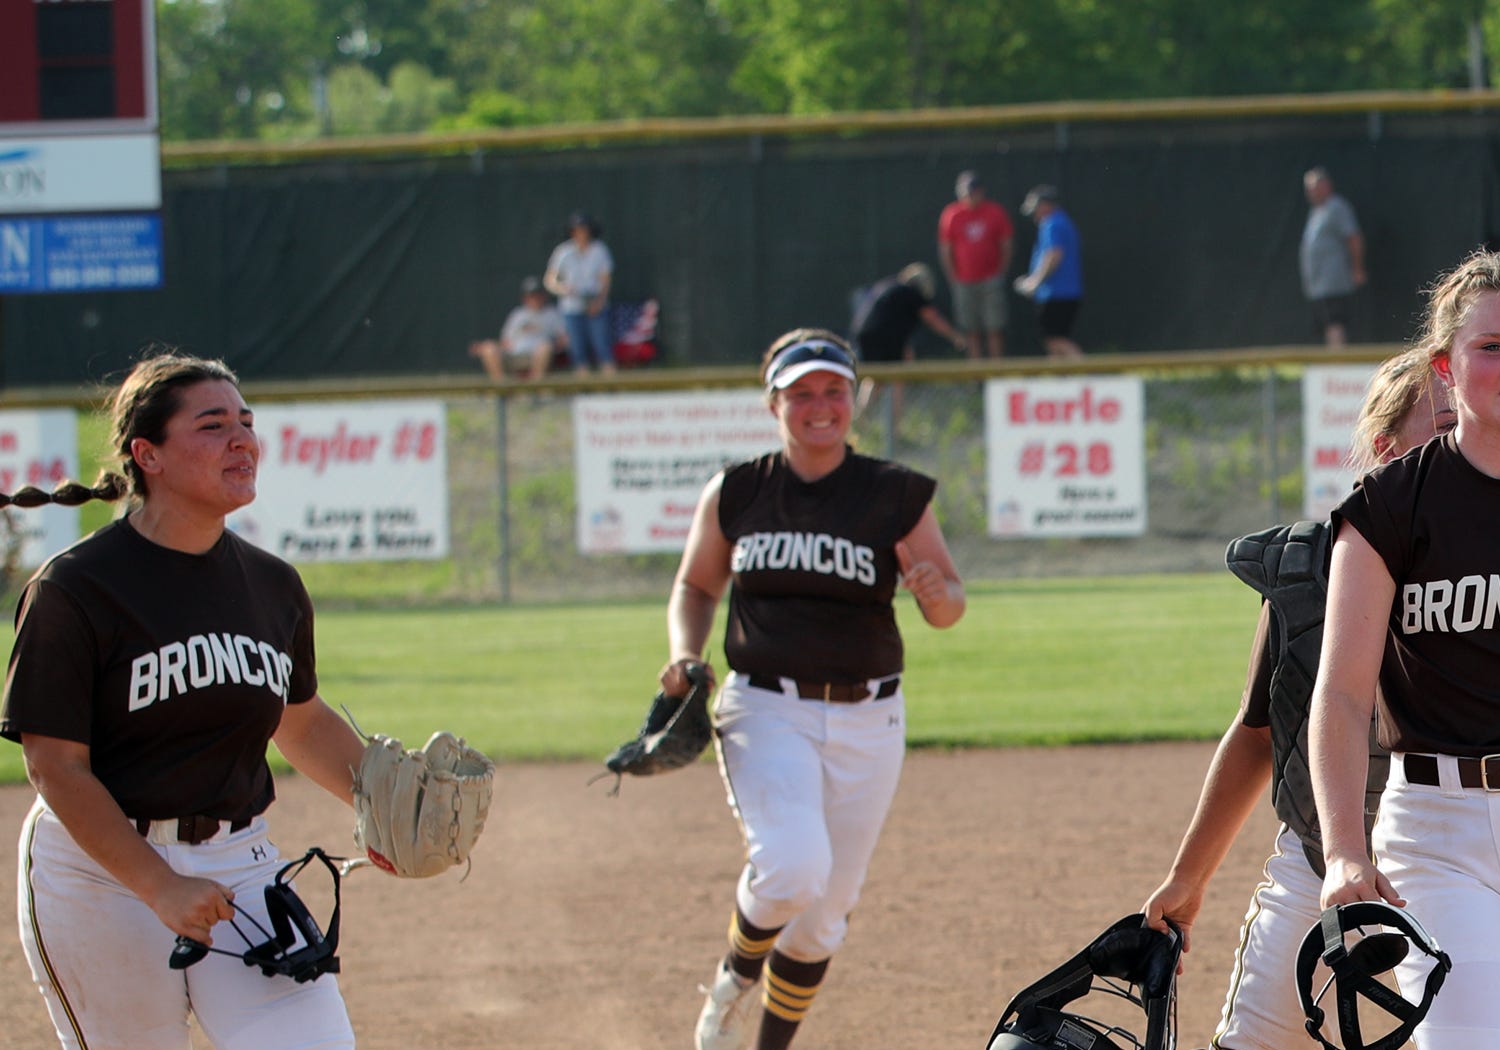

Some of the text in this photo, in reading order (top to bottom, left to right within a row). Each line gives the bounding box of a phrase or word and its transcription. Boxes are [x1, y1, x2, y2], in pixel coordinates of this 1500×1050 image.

[1008, 387, 1122, 424] Earle
[281, 421, 380, 474] Taylor
[393, 422, 438, 461] #8
[731, 531, 876, 586] BRONCOS
[128, 632, 294, 713] BRONCOS
